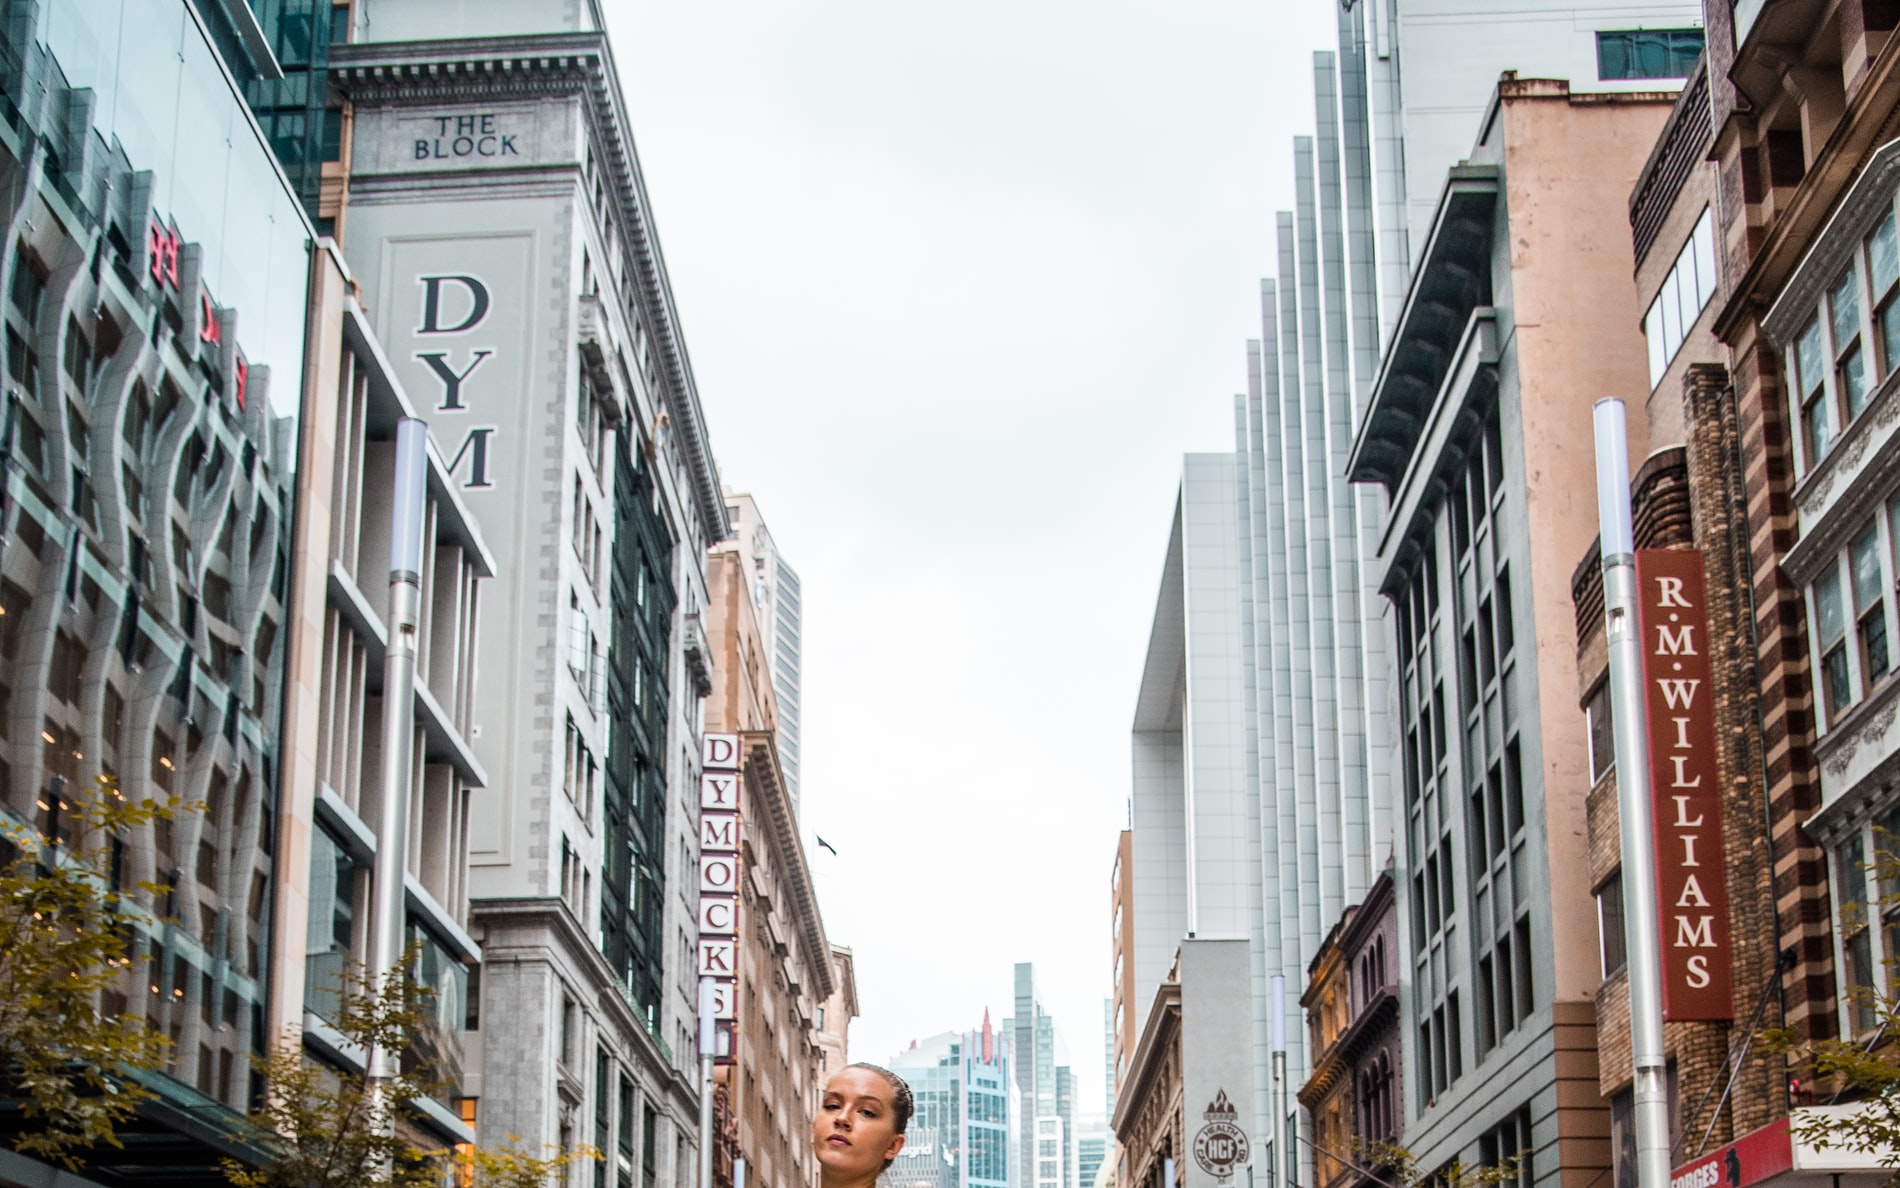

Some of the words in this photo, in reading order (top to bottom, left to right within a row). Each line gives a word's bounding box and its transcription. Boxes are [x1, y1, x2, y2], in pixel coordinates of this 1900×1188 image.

[434, 114, 496, 137] THE
[414, 135, 519, 160] BLOCK
[1203, 1125, 1238, 1136] HEALTH
[1196, 1149, 1214, 1171] CARE
[1208, 1139, 1234, 1159] HCF
